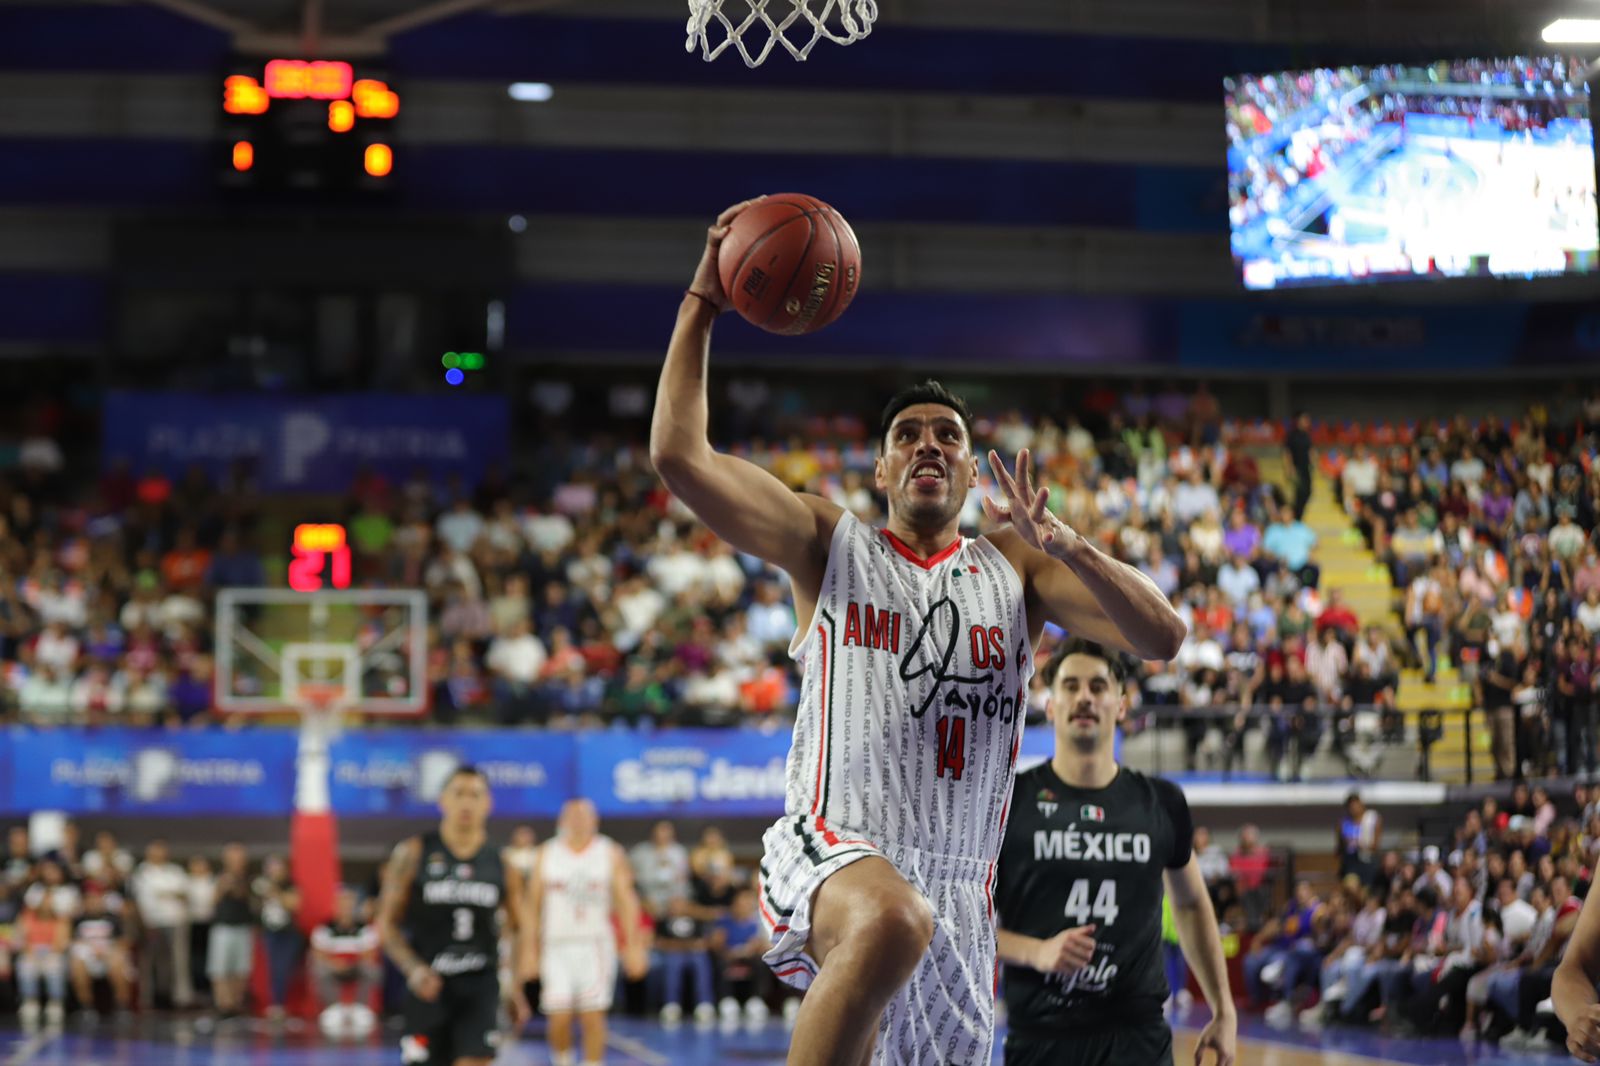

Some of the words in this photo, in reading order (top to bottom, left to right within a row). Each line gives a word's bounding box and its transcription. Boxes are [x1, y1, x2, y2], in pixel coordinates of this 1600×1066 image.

[848, 536, 856, 590] SUPERCOPA
[976, 592, 984, 612] LIGA
[992, 584, 1003, 620] MADRID
[845, 679, 853, 718] MADRID
[917, 744, 924, 756] DE
[935, 714, 965, 780] 14
[982, 748, 990, 774] COPA
[613, 760, 696, 803] San
[702, 757, 787, 800] Javi
[1034, 822, 1151, 863] MÉXICO
[1064, 878, 1119, 926] 44
